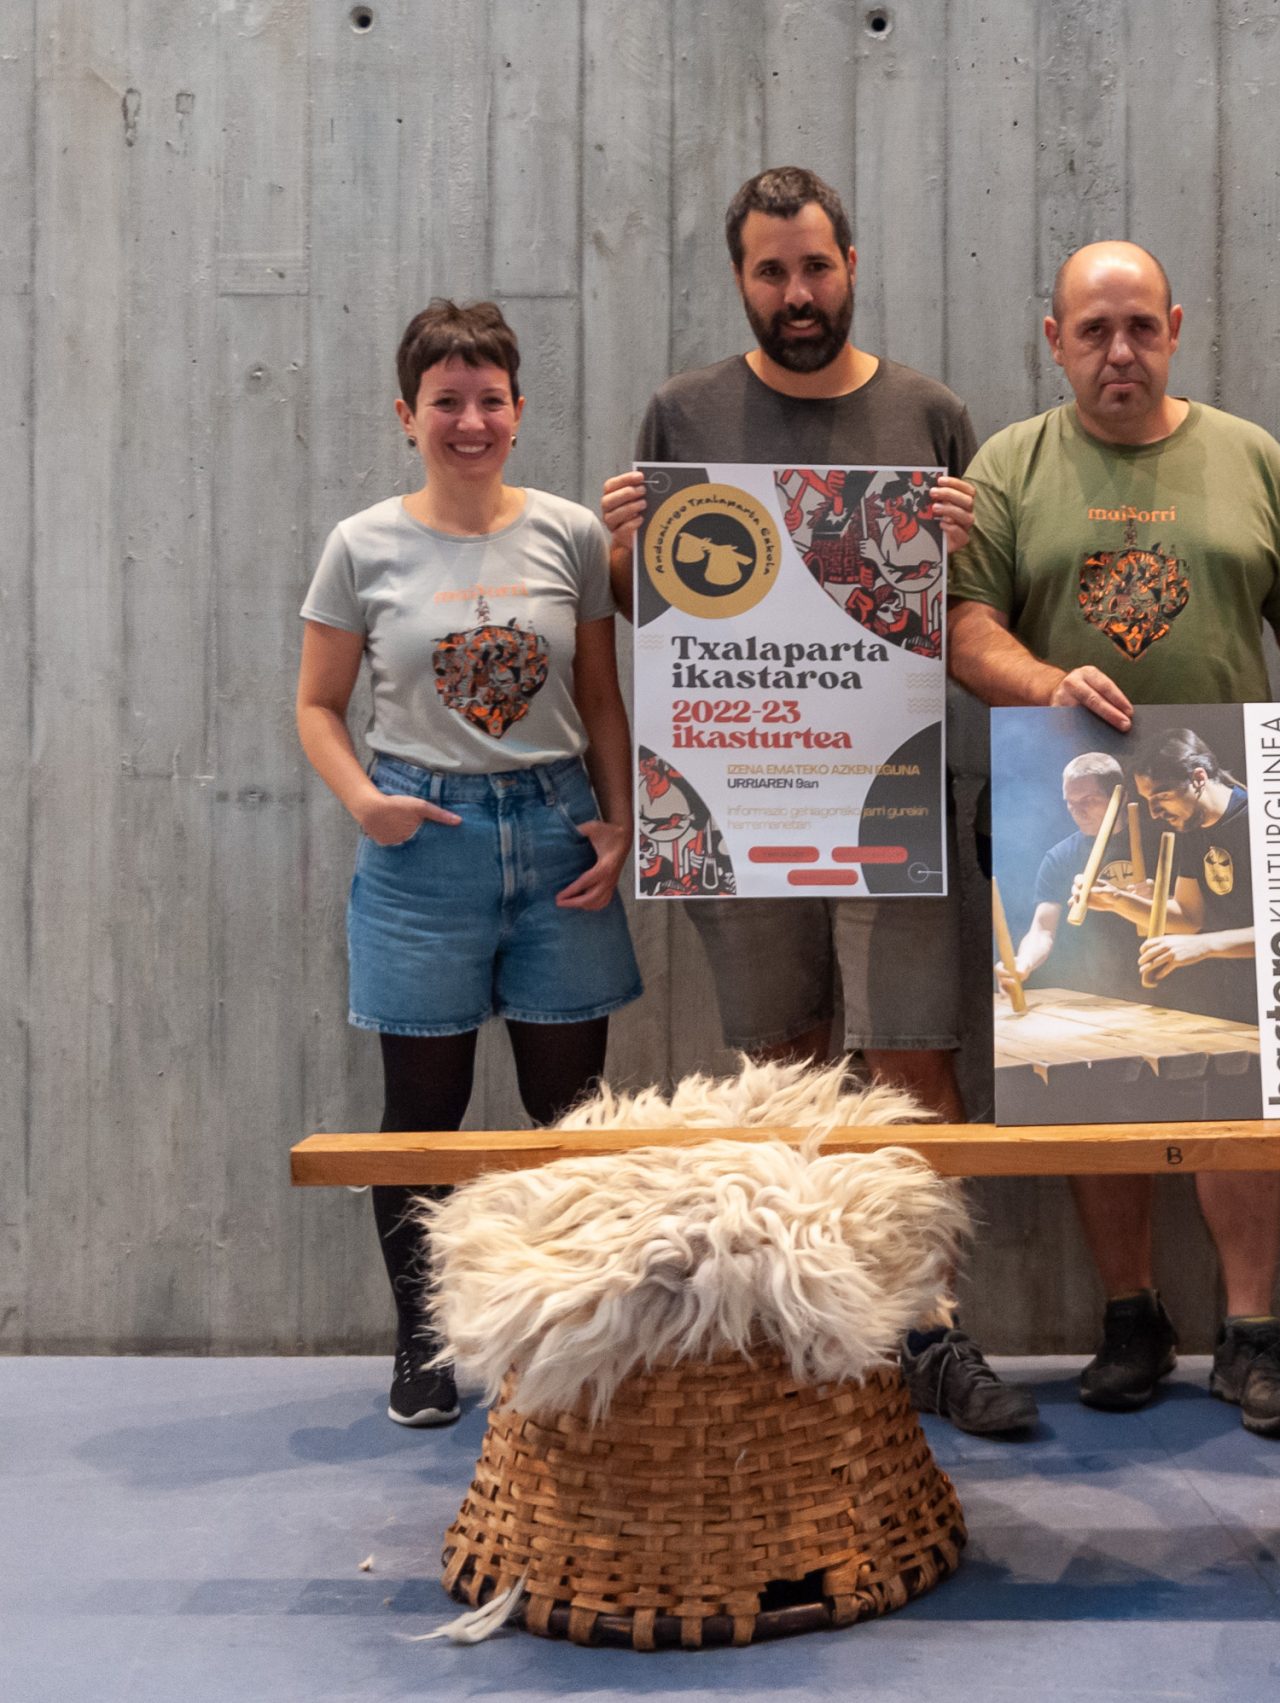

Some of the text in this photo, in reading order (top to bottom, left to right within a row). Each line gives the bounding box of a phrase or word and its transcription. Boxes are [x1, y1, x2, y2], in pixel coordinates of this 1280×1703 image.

[671, 635, 890, 668] Txalaparta
[671, 662, 863, 690] ikastaroa
[671, 699, 802, 724] 2022-23
[671, 723, 853, 750] ikasturtea
[727, 764, 921, 776] IZENA EMATEKO AZKEN EGUNA
[727, 778, 819, 789] URRIAREN 9an
[1167, 1146, 1183, 1164] B
